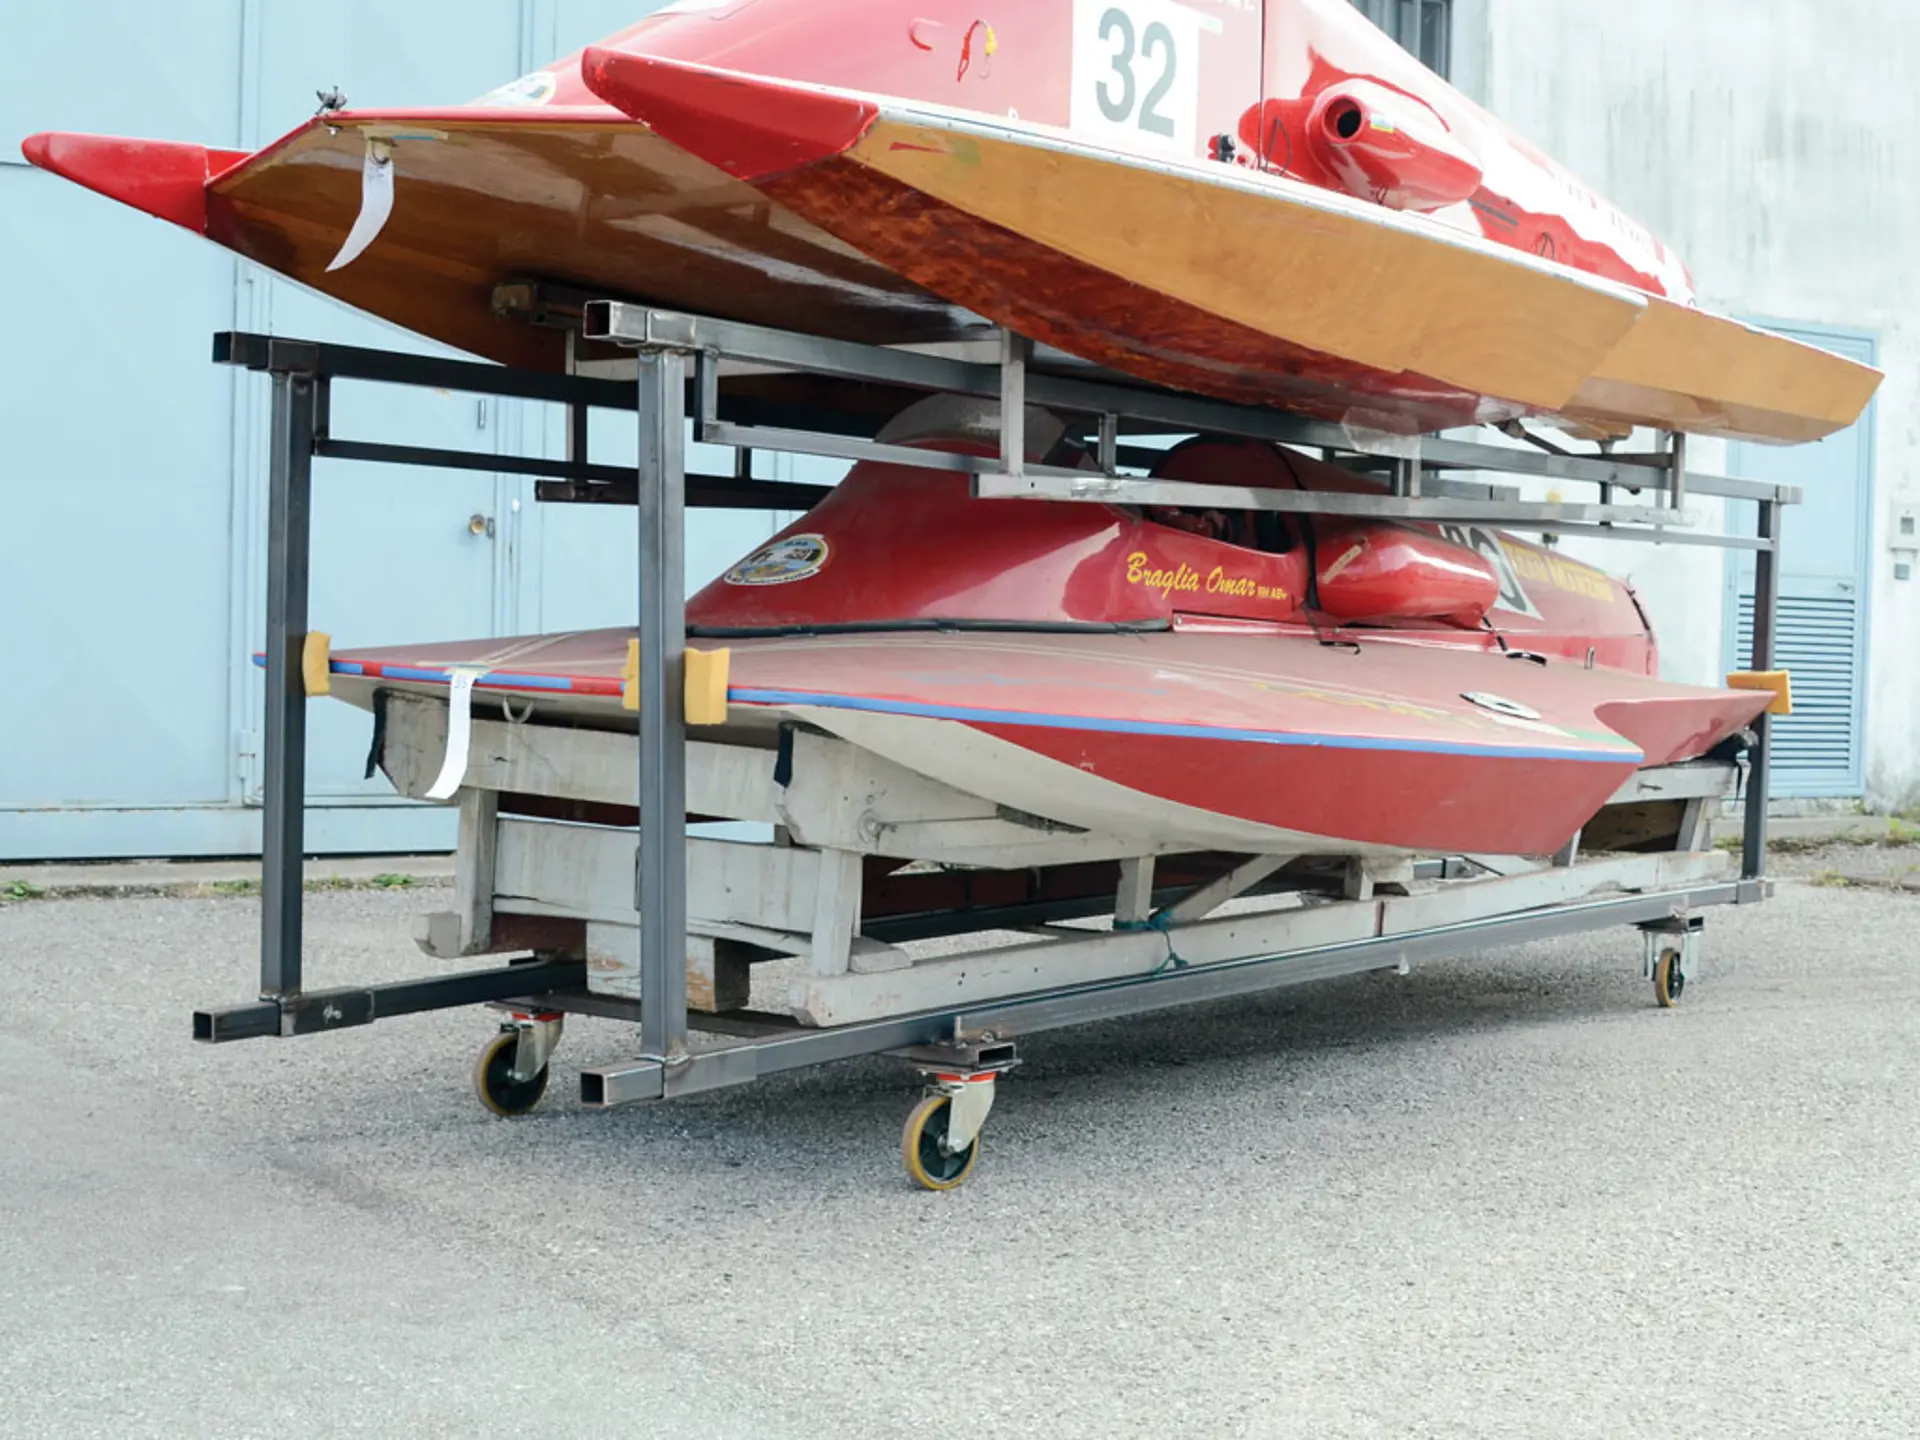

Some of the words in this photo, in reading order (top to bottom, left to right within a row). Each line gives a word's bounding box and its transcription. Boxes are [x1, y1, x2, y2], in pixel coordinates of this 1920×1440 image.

[1095, 7, 1177, 138] 32
[1126, 551, 1200, 599] Braglia
[1206, 565, 1256, 597] Omar
